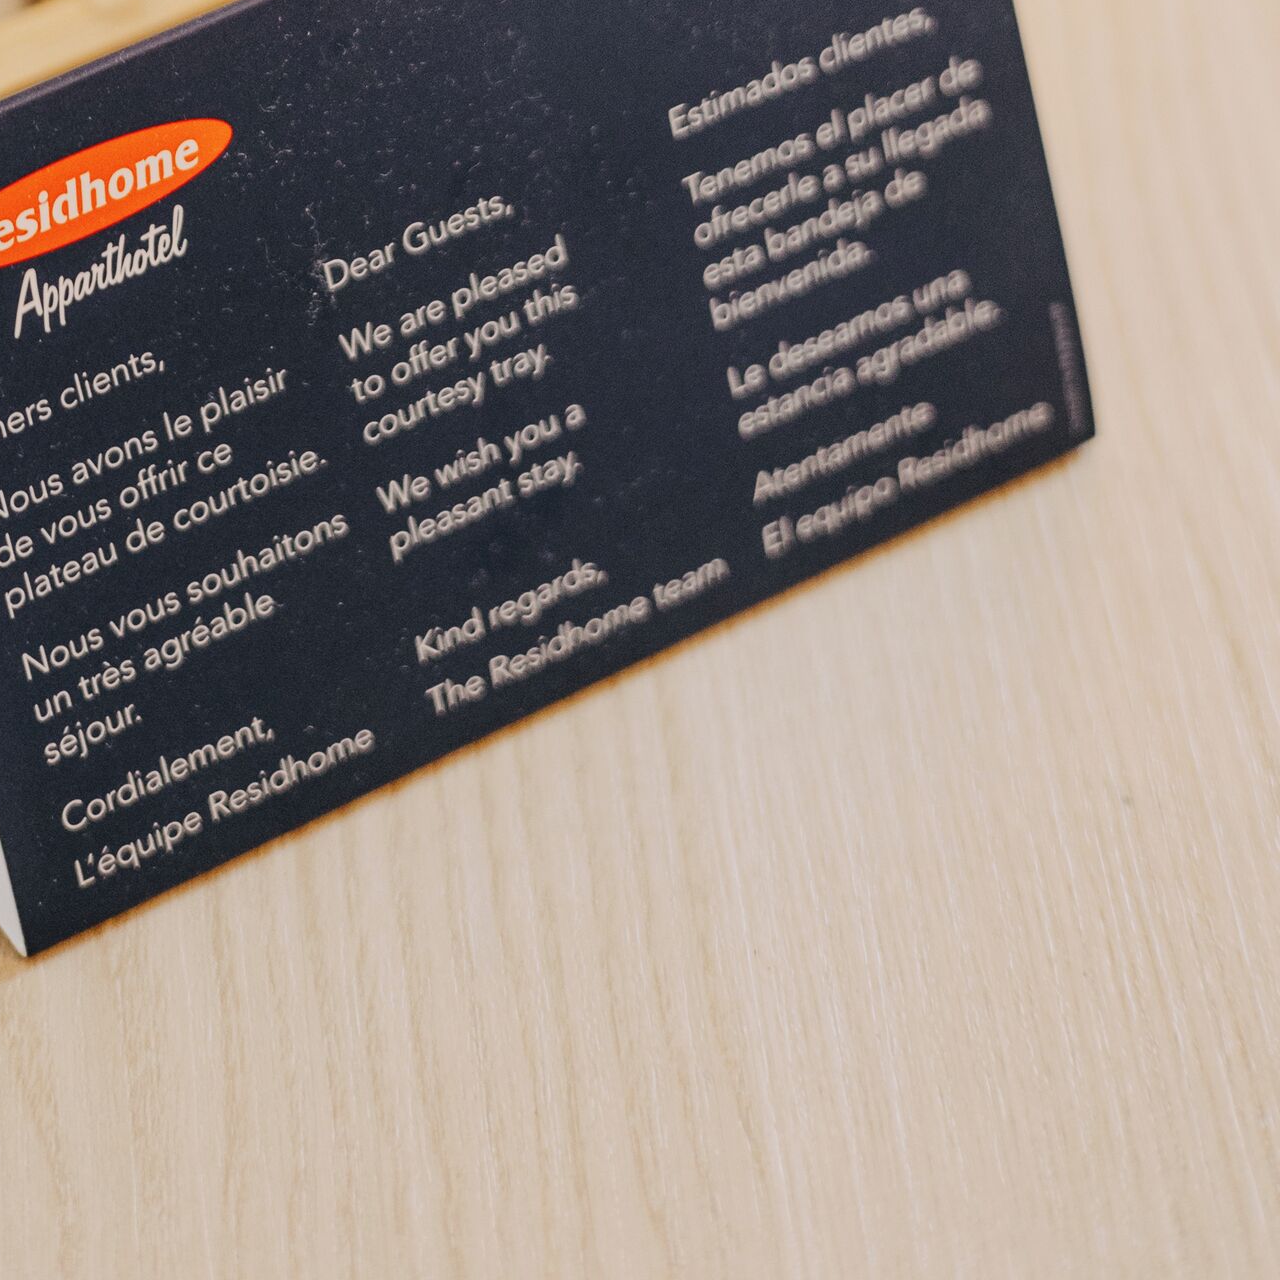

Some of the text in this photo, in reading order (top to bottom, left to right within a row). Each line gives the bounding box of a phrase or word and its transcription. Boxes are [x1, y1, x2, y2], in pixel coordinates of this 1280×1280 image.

[668, 55, 819, 139] Estimados
[682, 55, 984, 206] Tenemos el placer de
[694, 96, 992, 250] ofrecerle a su llegada
[703, 168, 928, 289] esta bandeja de
[14, 205, 187, 339] Apparthotel
[323, 194, 514, 293] Dear Guests,
[339, 233, 568, 362] We are pleased
[710, 239, 877, 332] bienvenida.
[61, 351, 165, 409] clients,
[350, 282, 579, 405] to offer you this
[727, 268, 971, 400] Le deseamos una
[71, 429, 158, 484] avons
[163, 410, 192, 442] le
[201, 366, 288, 433] plaisir
[363, 343, 552, 445] courtesy tray.
[738, 367, 856, 442] estancia
[41, 499, 112, 546] vous
[120, 461, 188, 510] offrir
[197, 443, 233, 475] ce
[376, 403, 587, 514] We wish you a
[389, 450, 582, 564] pleasant stay.
[762, 402, 1056, 559] El equipo Residhome
[5, 449, 328, 618] plateau de courtoisie.
[22, 511, 349, 681] Nous vous souhaitons
[415, 558, 608, 663] Kind regards,
[425, 558, 731, 716] The Residhome team
[34, 591, 276, 723] un très agréable
[43, 701, 142, 765] séjour.
[61, 716, 275, 832] Cordialement,
[74, 727, 377, 889] L'équipe Residhome
